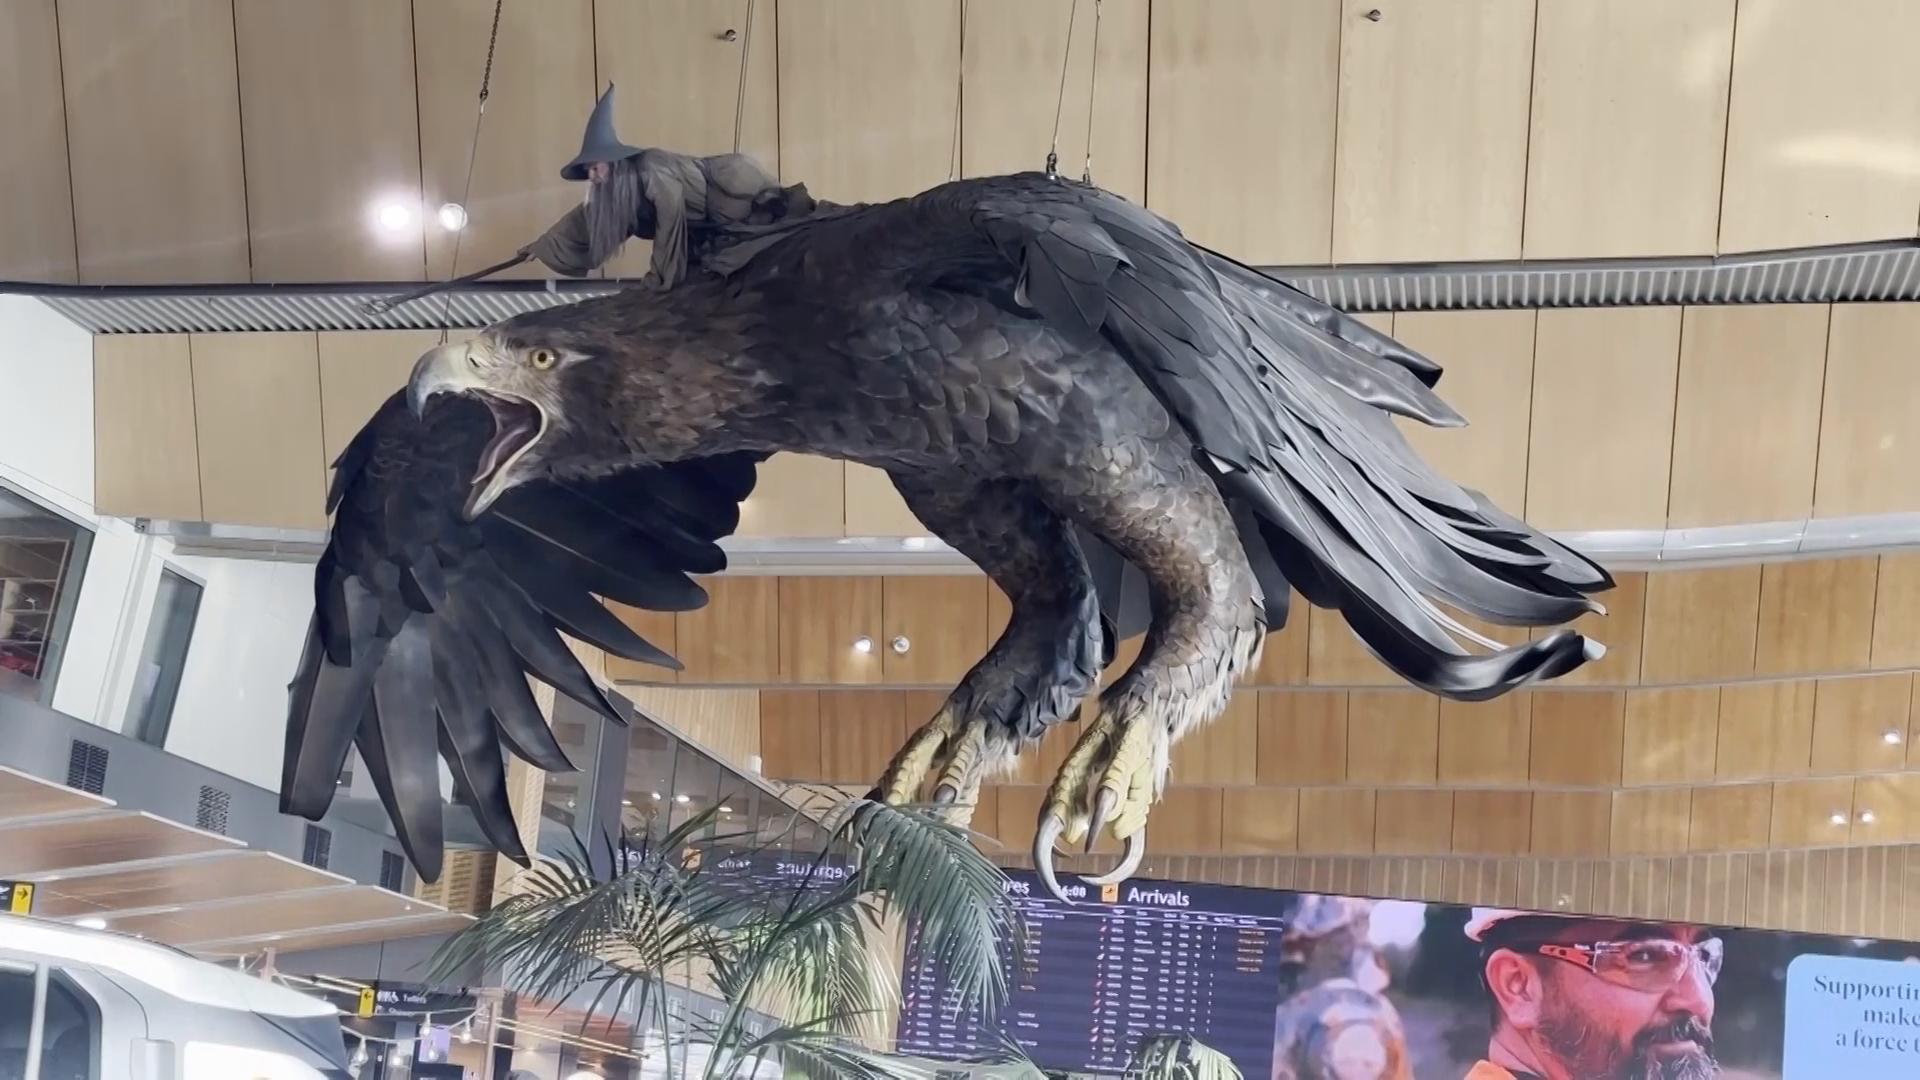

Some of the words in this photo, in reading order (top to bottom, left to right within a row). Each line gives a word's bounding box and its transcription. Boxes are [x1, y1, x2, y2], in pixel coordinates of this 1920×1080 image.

[1057, 885, 1086, 898] 6:08
[1128, 887, 1190, 907] Arrivals
[1835, 1033, 1847, 1047] a
[1853, 1029, 1907, 1052] force
